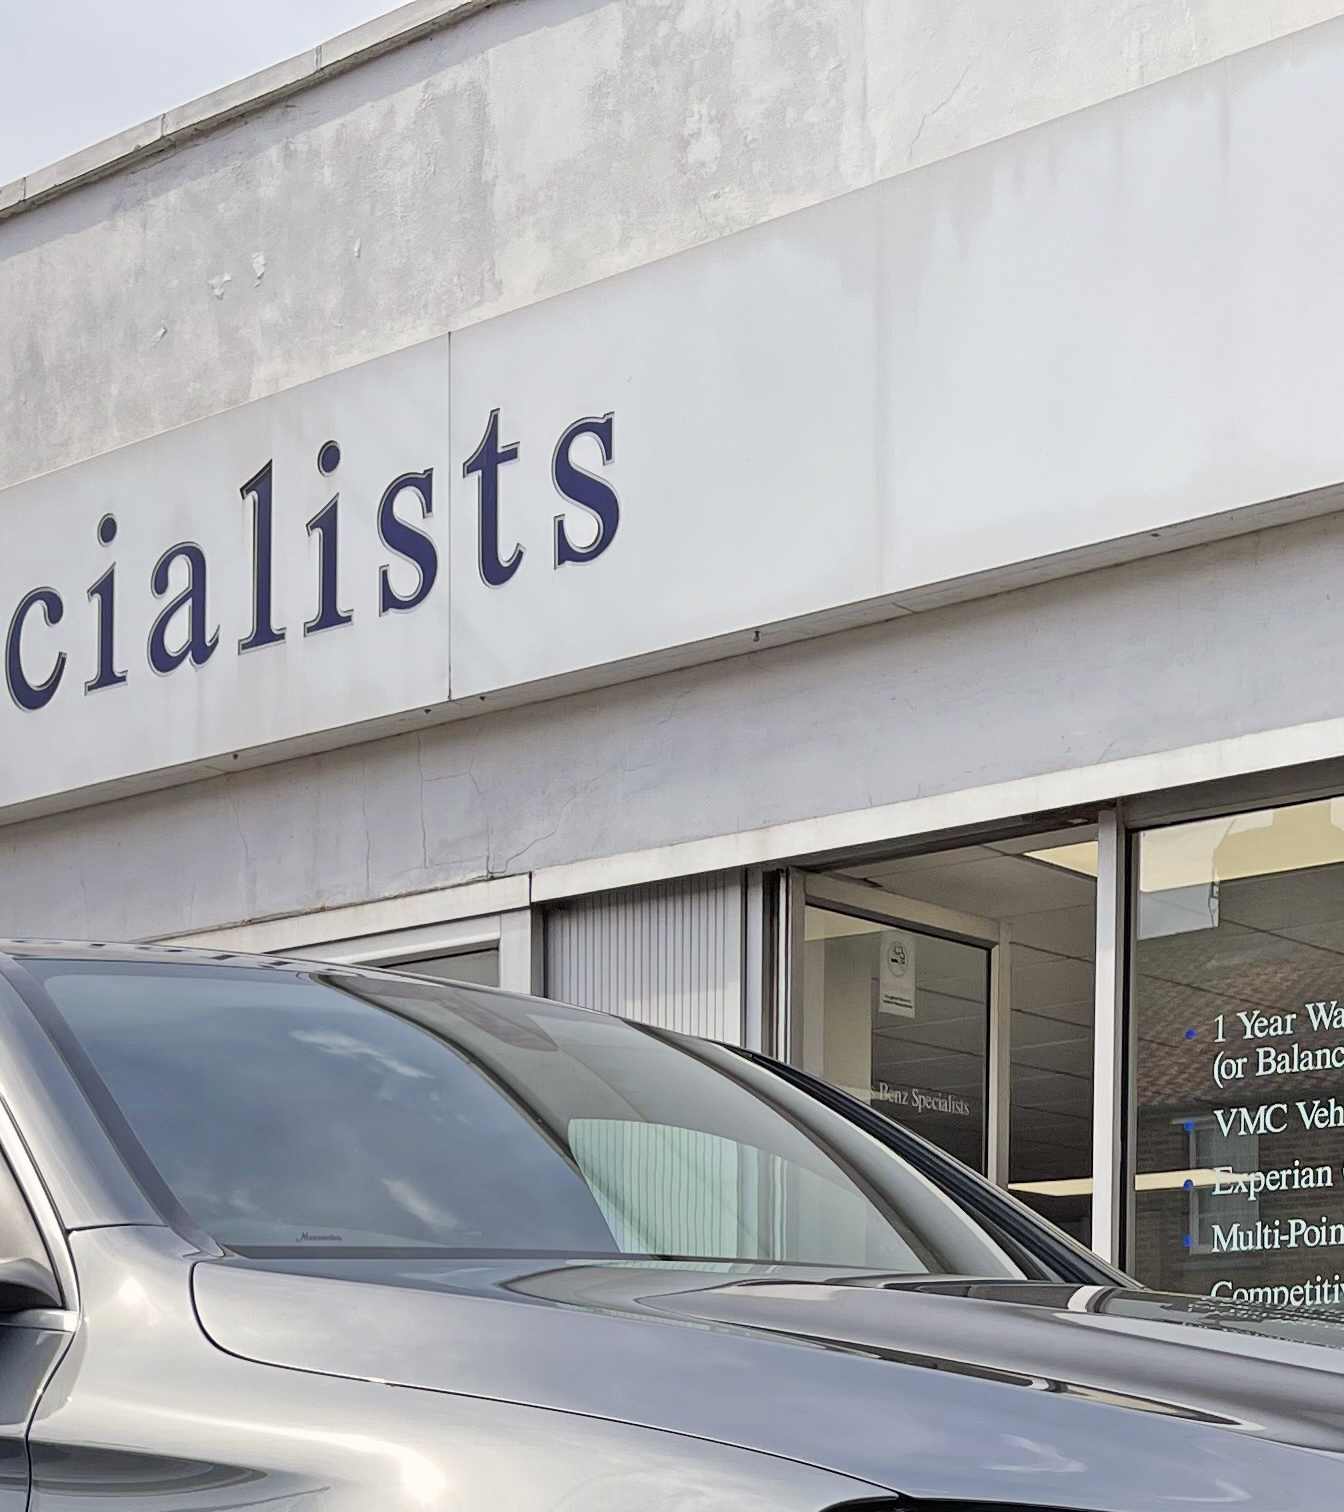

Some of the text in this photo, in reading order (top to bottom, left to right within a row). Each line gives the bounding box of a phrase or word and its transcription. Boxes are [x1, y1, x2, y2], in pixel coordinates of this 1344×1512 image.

[1213, 1014, 1227, 1043] 1
[1237, 1010, 1297, 1040] Year
[1212, 1050, 1249, 1089] (or
[879, 1082, 909, 1105] Benz
[911, 1088, 971, 1116] Specialists
[1213, 1103, 1288, 1137] VMC
[1212, 1159, 1334, 1201] Experian
